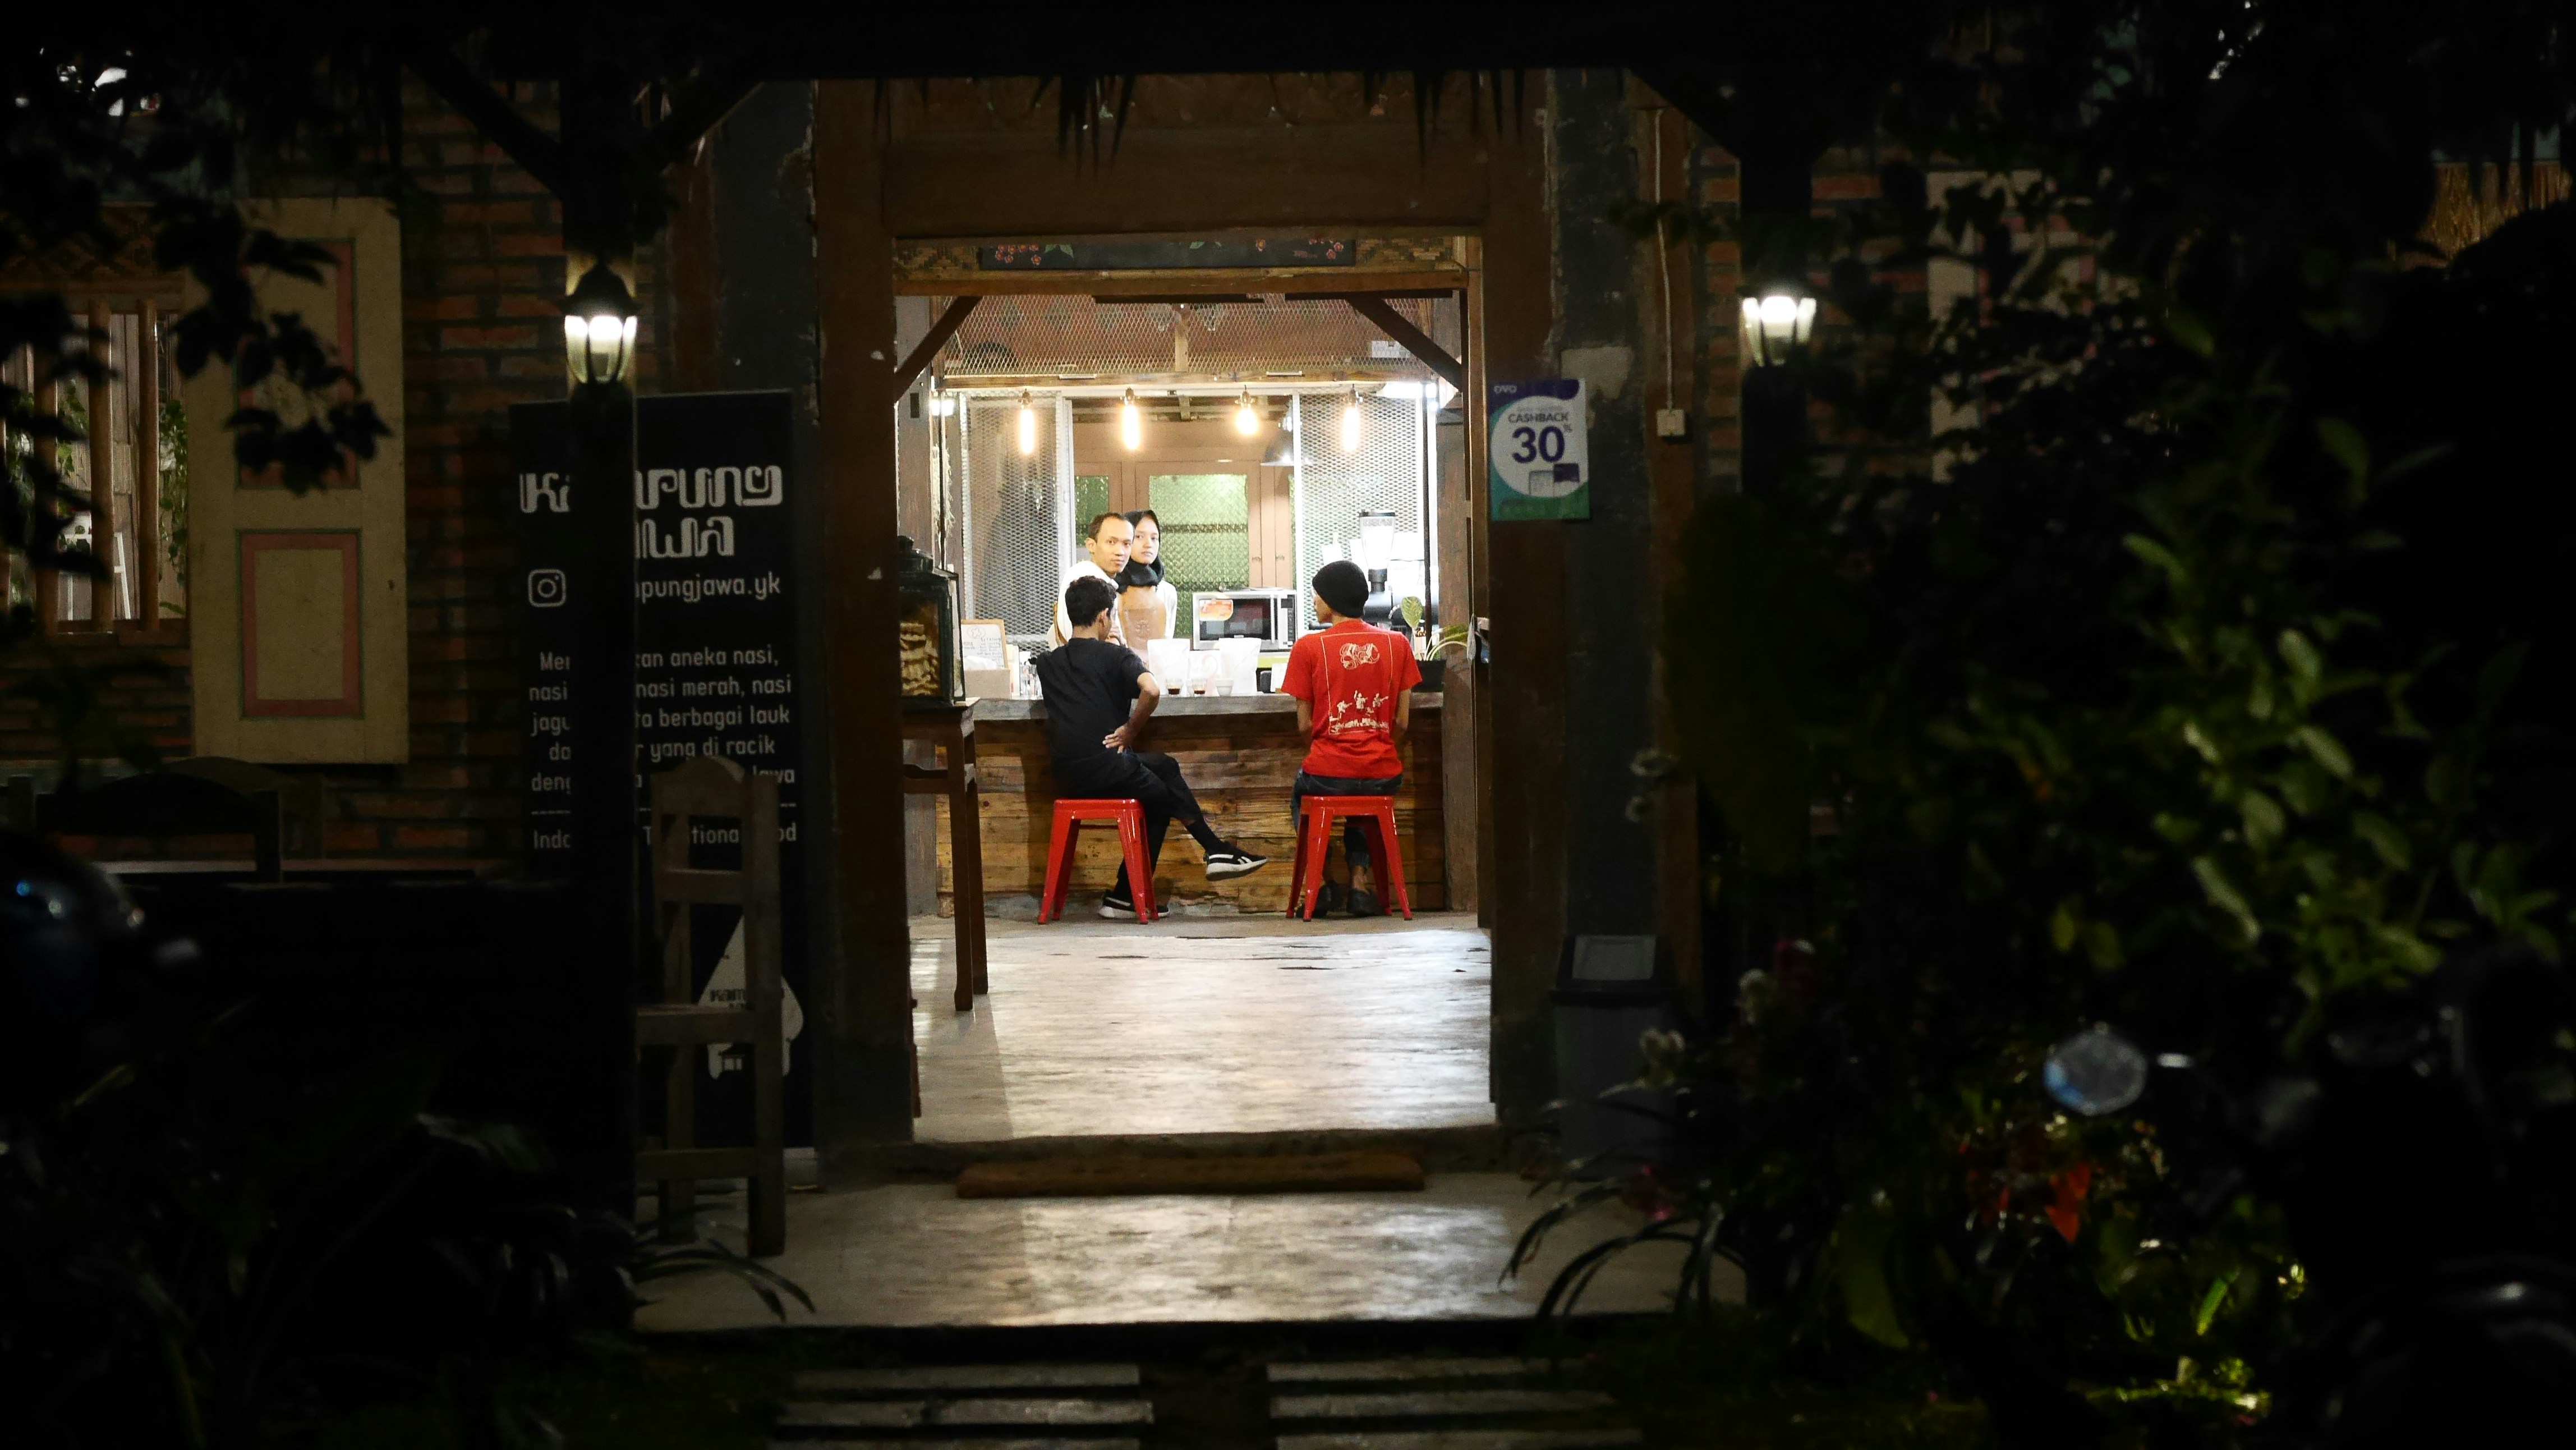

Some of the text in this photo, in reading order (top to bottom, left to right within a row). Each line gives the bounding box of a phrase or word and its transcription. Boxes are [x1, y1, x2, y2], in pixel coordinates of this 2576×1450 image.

[1508, 412, 1570, 423] CASHBACK
[670, 646, 726, 667] aneka
[733, 644, 778, 667] nasi,
[529, 673, 792, 701] nasi nasi merah, nasi
[659, 705, 742, 731] berbagai
[750, 704, 790, 724] lauk
[650, 742, 696, 763] yang
[702, 736, 719, 756] di
[726, 735, 775, 755] racik
